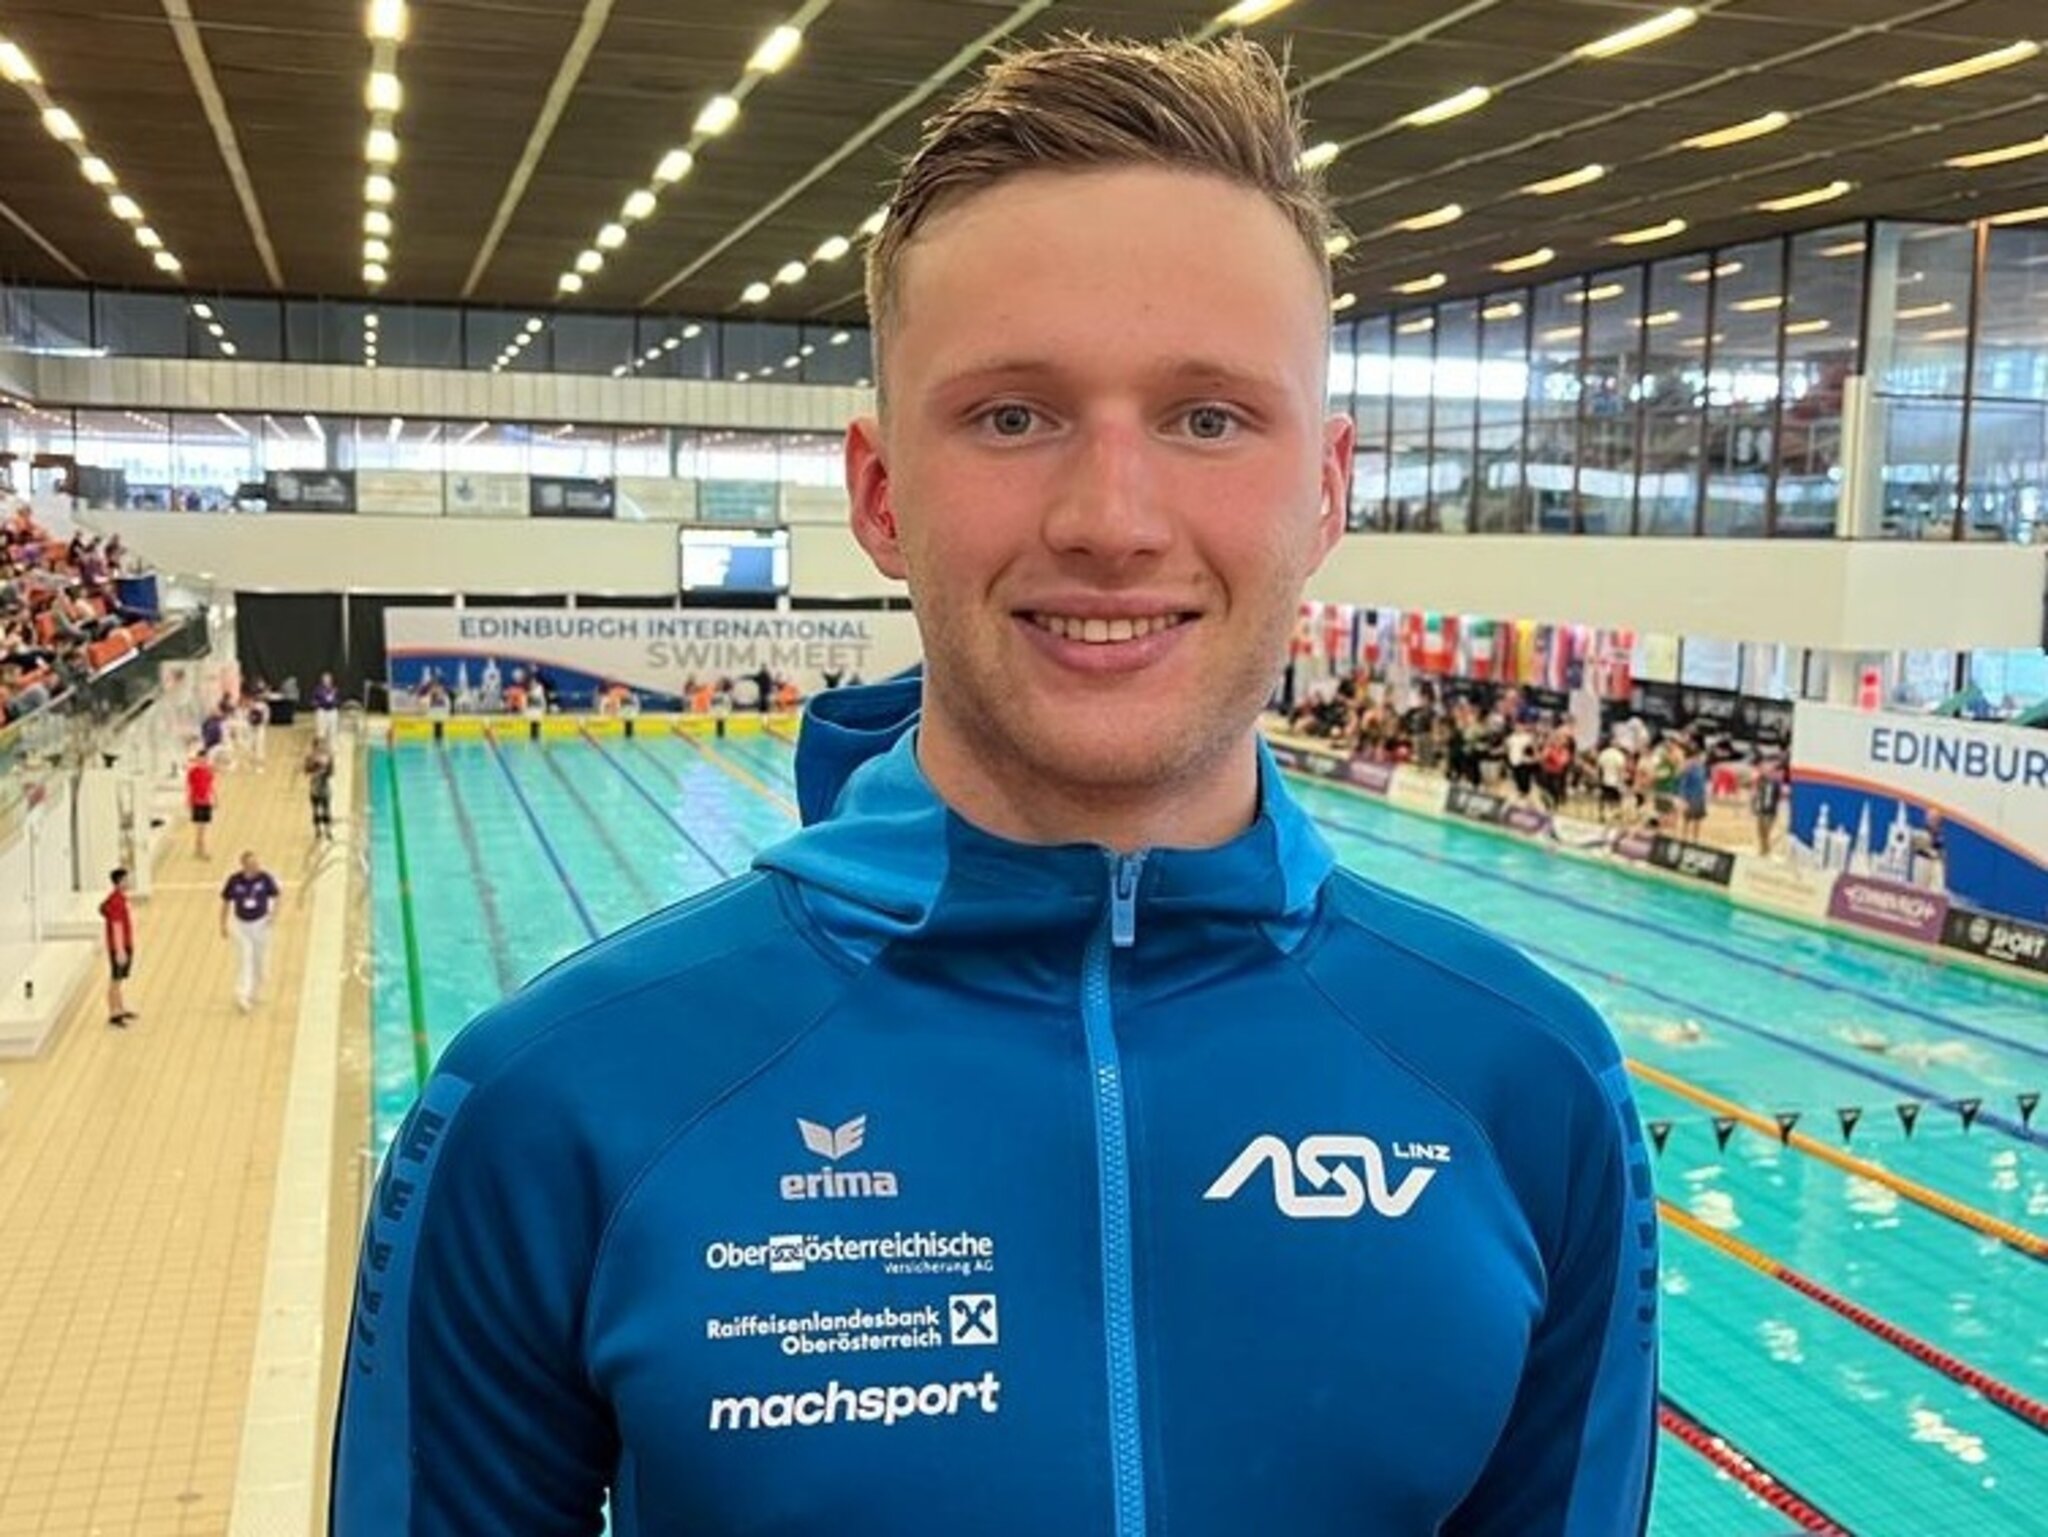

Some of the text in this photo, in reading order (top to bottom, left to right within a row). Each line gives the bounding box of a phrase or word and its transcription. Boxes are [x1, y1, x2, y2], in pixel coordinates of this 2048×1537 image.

[460, 616, 871, 641] EDINBURGH INTERNATIONAL
[647, 641, 869, 669] SWIM MEET
[1392, 1142, 1452, 1162] LINZ
[780, 1166, 898, 1200] erima
[973, 1259, 994, 1272] AG
[706, 1305, 940, 1339] Raiffeisenlandesbank
[780, 1328, 942, 1356] Oberösterreich
[709, 1371, 1000, 1430] machsport
